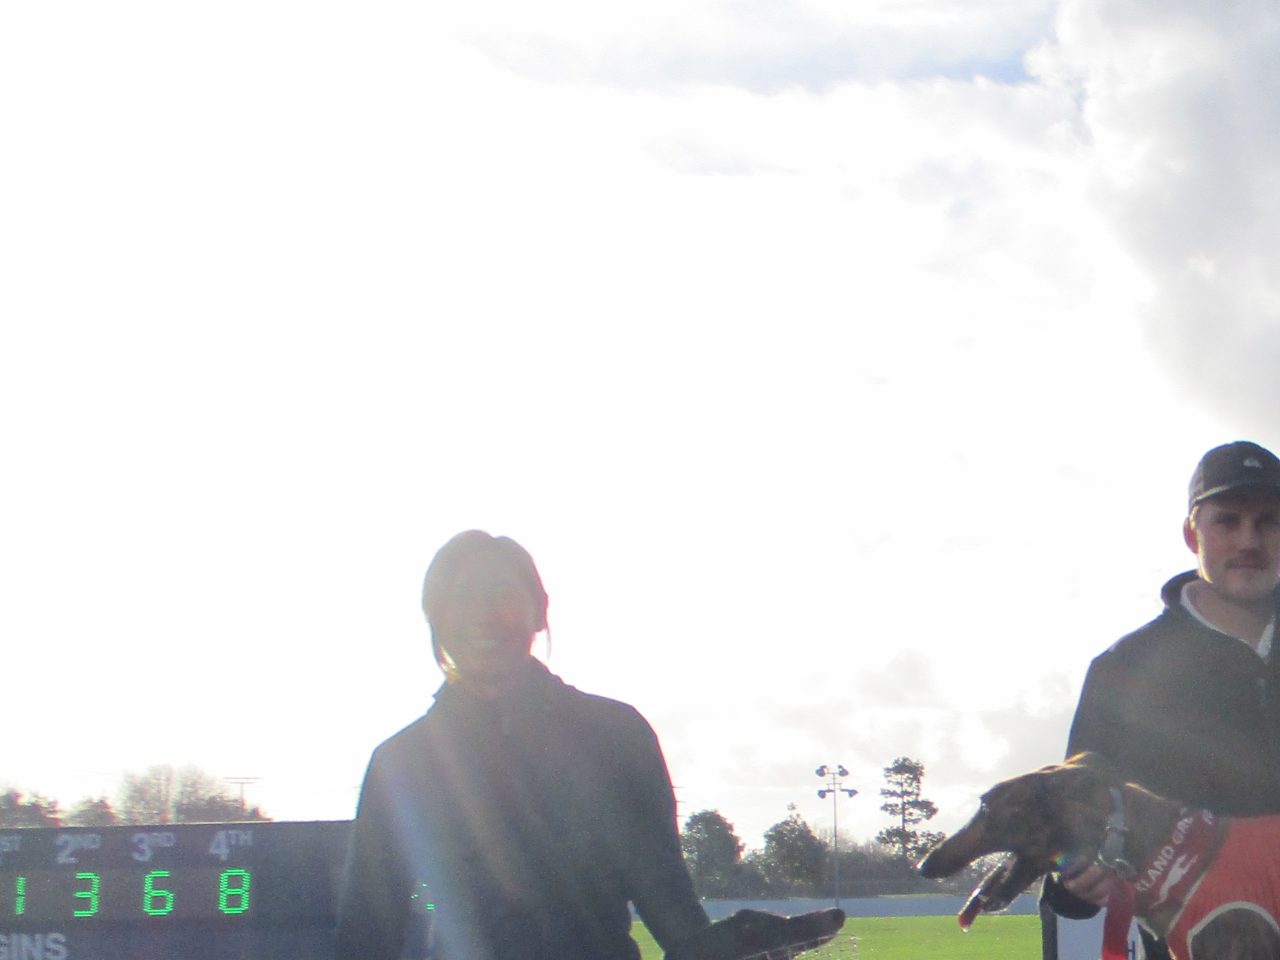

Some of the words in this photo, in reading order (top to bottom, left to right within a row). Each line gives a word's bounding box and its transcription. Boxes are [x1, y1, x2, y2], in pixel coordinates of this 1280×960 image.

[55, 833, 101, 864] 2ND
[131, 832, 176, 862] 3RD
[209, 829, 253, 861] 4TH
[15, 875, 27, 915] 1
[72, 871, 102, 918] 3
[143, 869, 175, 916] 6
[218, 867, 252, 915] 8
